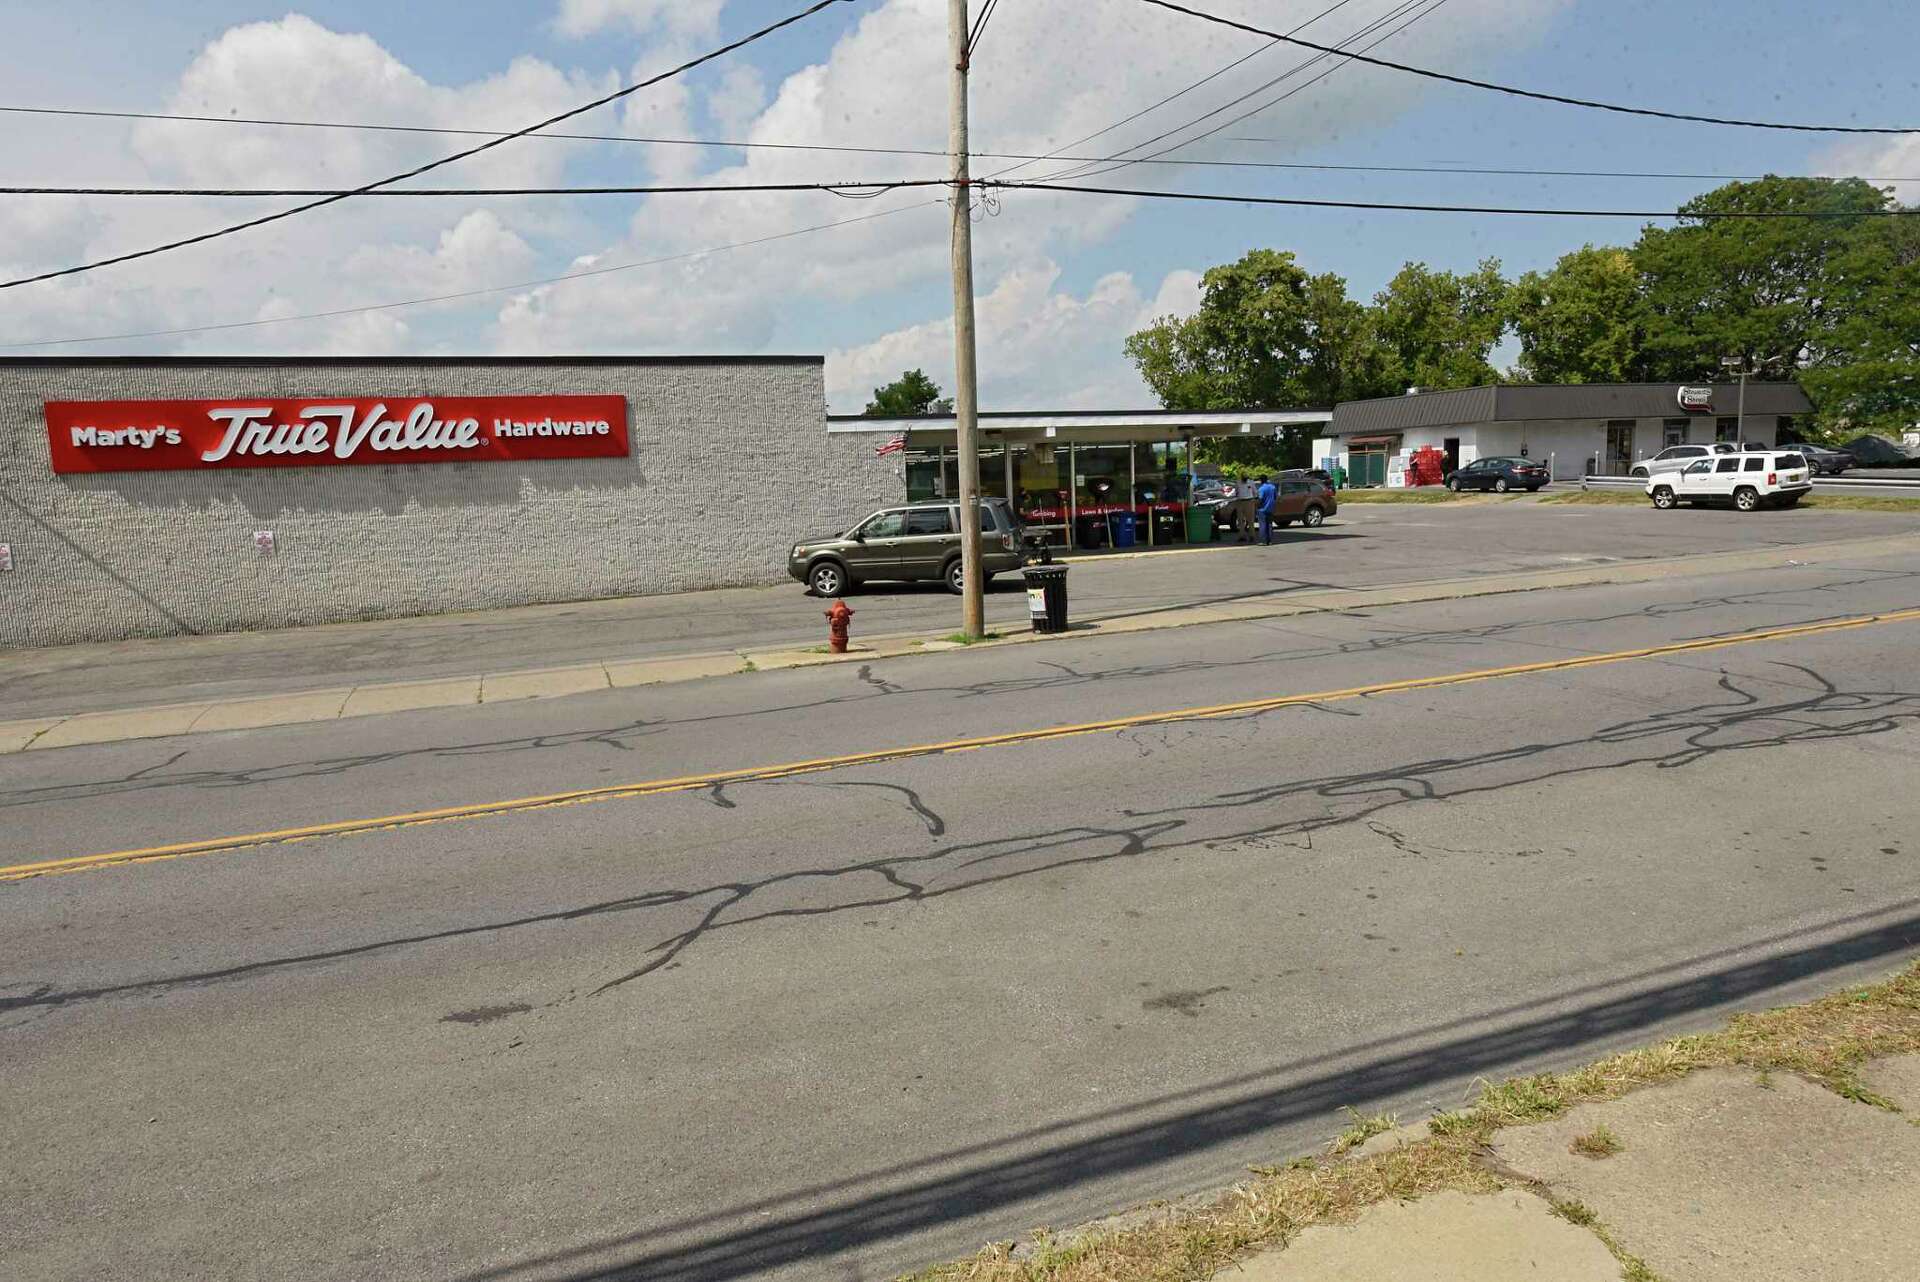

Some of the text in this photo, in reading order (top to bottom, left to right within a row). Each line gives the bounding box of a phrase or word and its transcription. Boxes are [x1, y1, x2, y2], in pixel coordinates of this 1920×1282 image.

[70, 402, 610, 462] Marty's True Value Hardware
